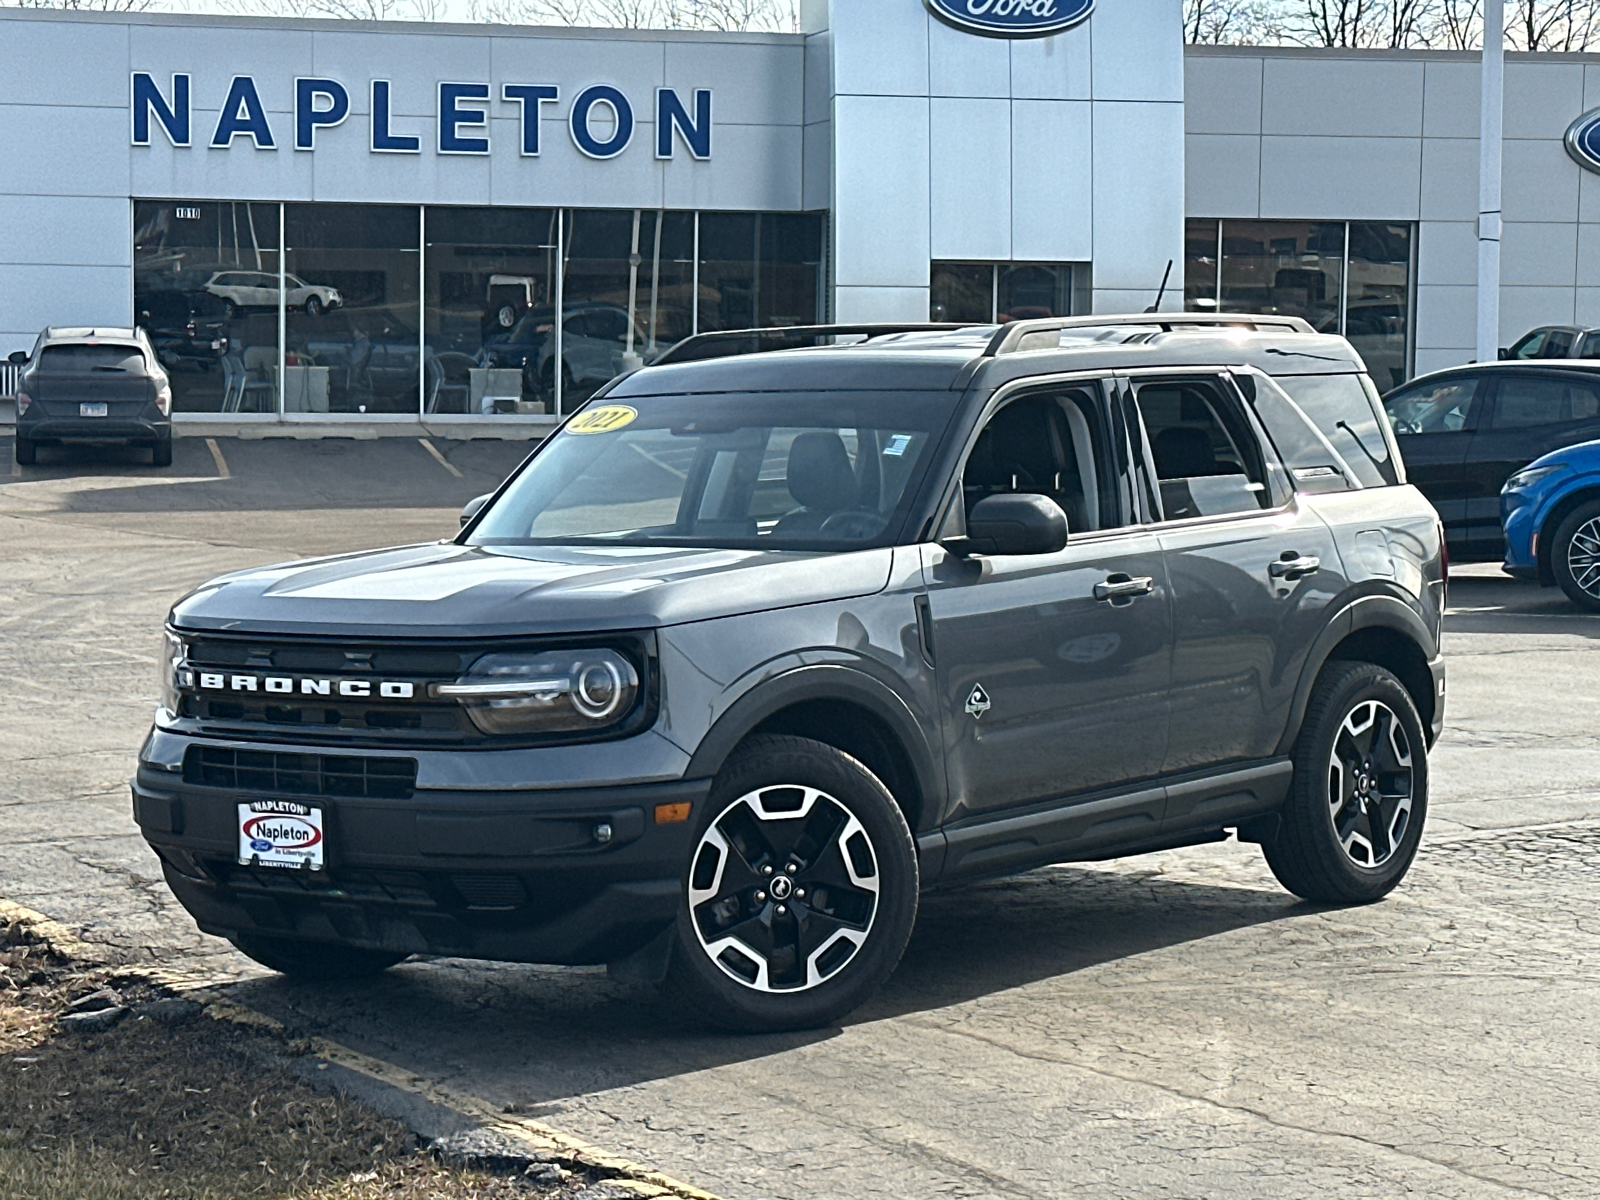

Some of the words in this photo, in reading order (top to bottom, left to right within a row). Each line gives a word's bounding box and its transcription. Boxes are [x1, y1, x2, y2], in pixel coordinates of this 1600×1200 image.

[130, 70, 713, 161] NAPLETON
[177, 208, 200, 219] 1010
[571, 411, 630, 429] 2021
[200, 672, 414, 698] BRONCO
[253, 800, 305, 815] NAPLETON
[256, 822, 309, 842] Napleton
[258, 860, 302, 869] LIBERTYVILLE
